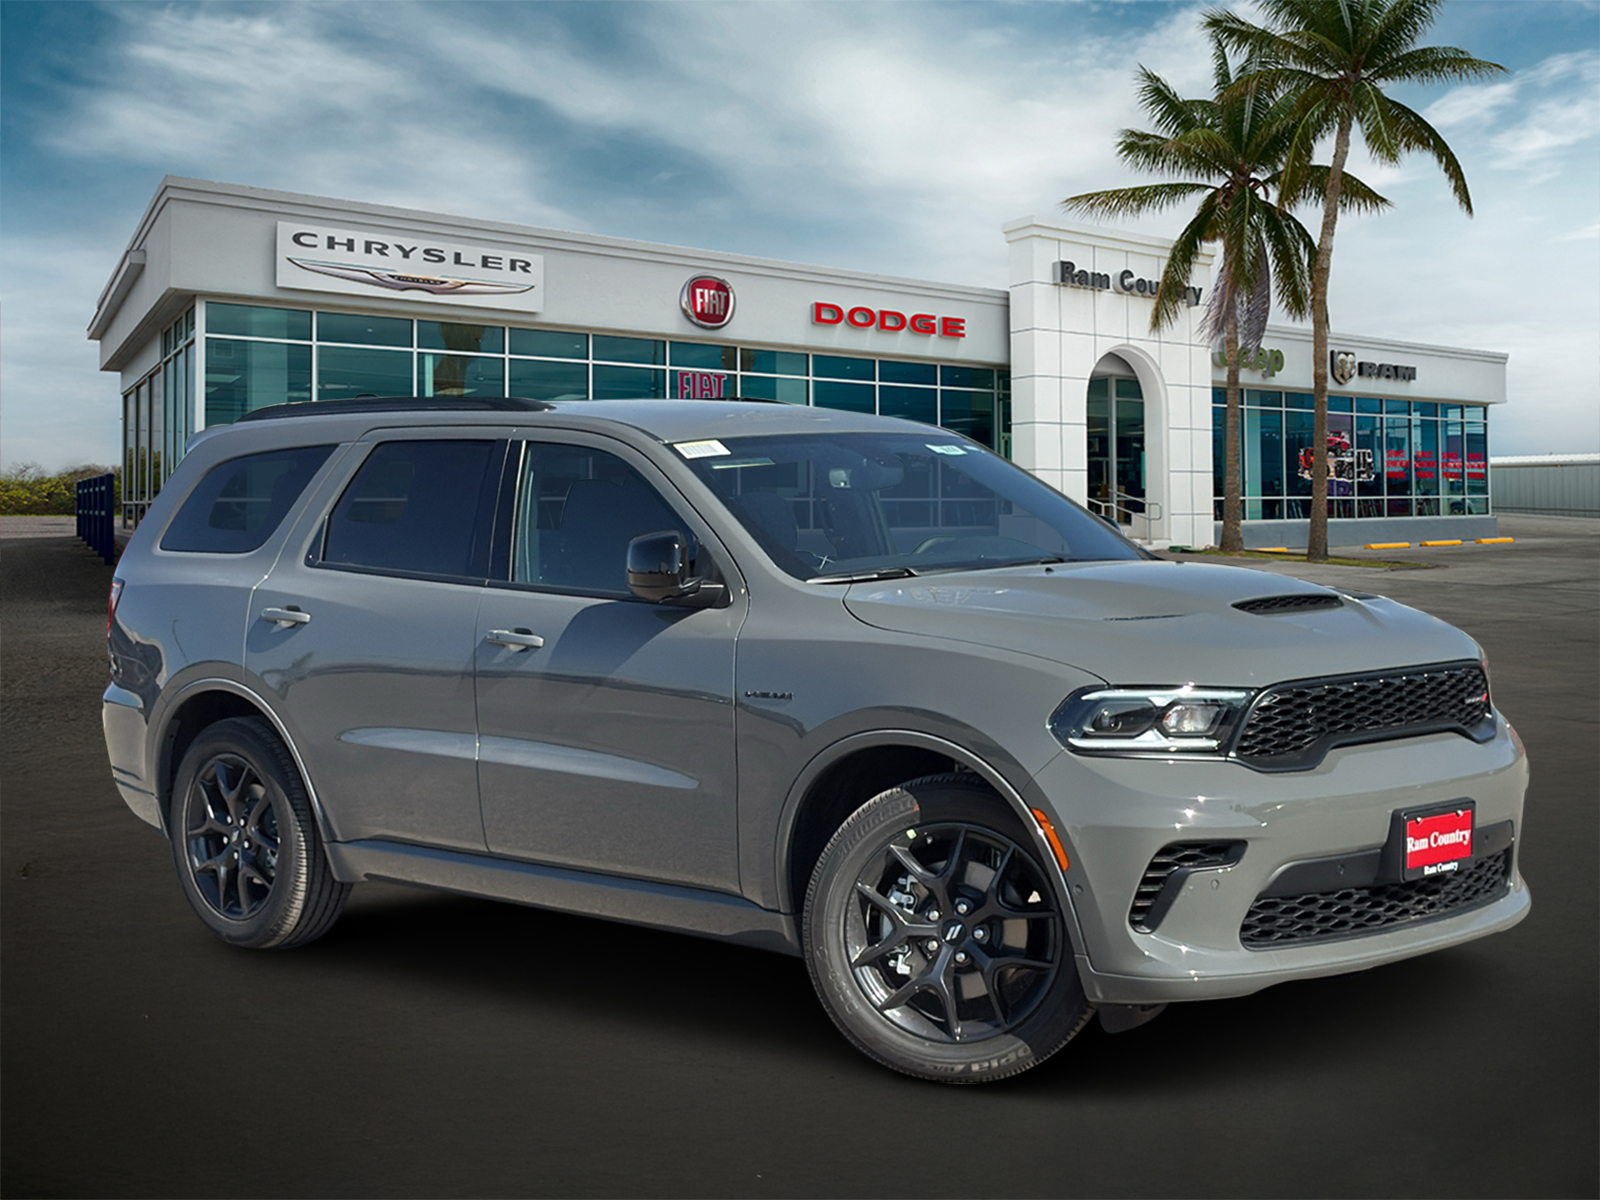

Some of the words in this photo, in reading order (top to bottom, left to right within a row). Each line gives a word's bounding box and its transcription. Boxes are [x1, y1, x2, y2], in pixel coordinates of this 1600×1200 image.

[291, 231, 533, 274] CHRYSLER
[1056, 260, 1111, 290] Ram
[1116, 269, 1203, 307] Coury
[695, 287, 728, 316] FIAT
[811, 301, 966, 339] DODGE
[678, 370, 728, 399] FIAT
[1357, 361, 1417, 382] RAM
[1407, 836, 1429, 854] Ram
[1430, 828, 1472, 848] Country
